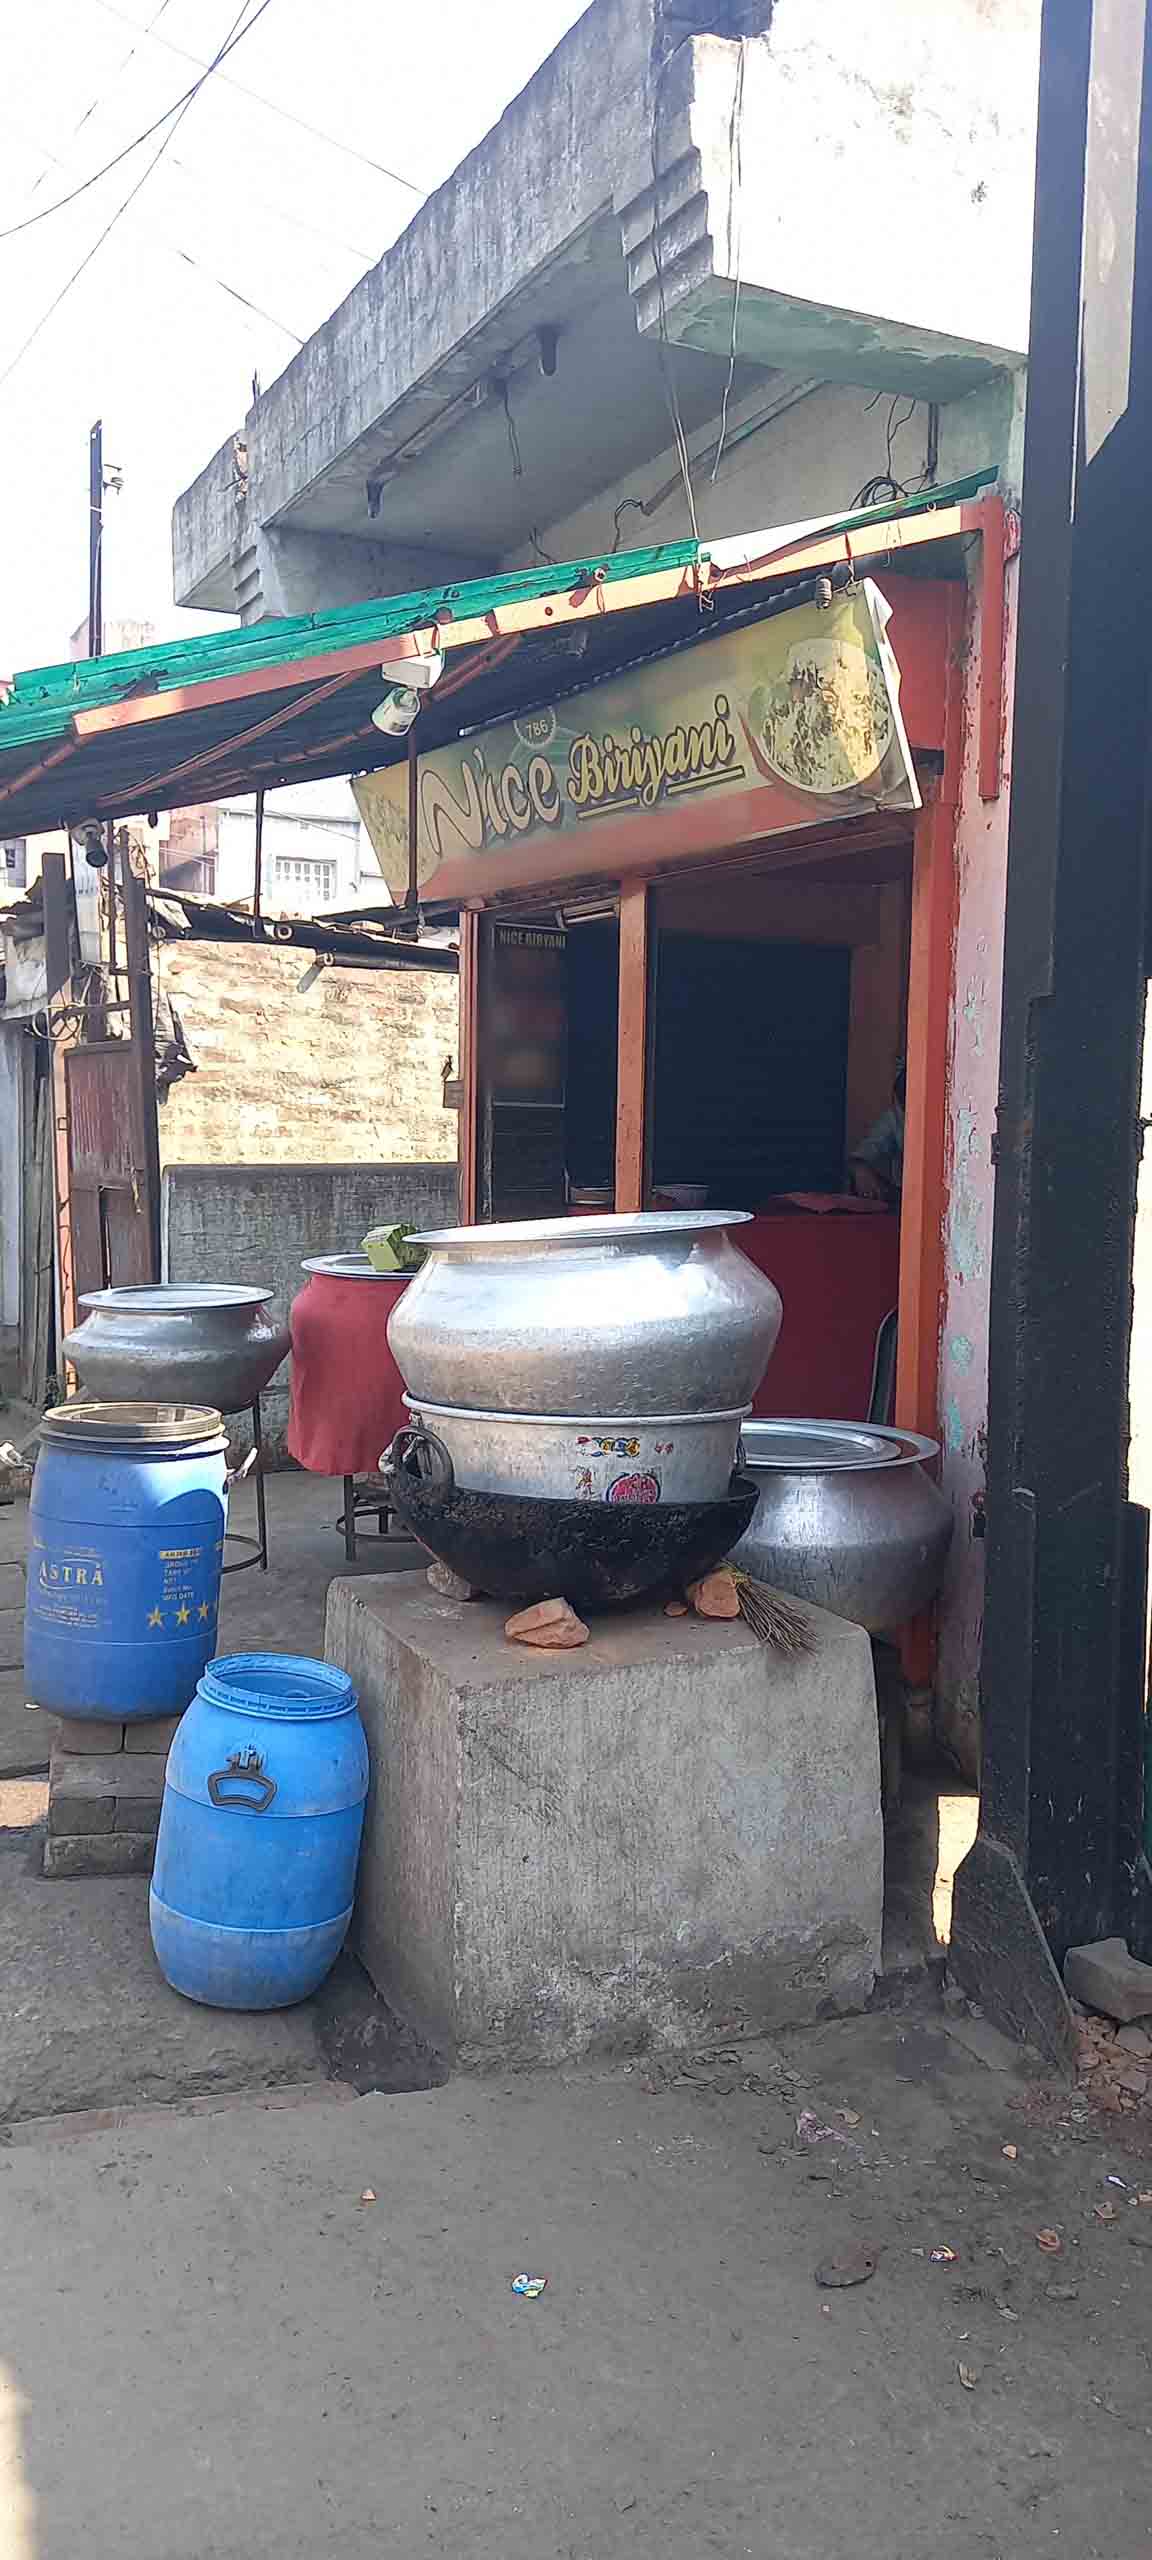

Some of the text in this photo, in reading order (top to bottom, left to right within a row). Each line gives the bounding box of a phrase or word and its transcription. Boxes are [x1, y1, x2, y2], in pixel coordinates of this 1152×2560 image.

[525, 719, 549, 740] 786
[421, 694, 734, 856] Nice Biriyani
[40, 1560, 104, 1586] ASTRA
